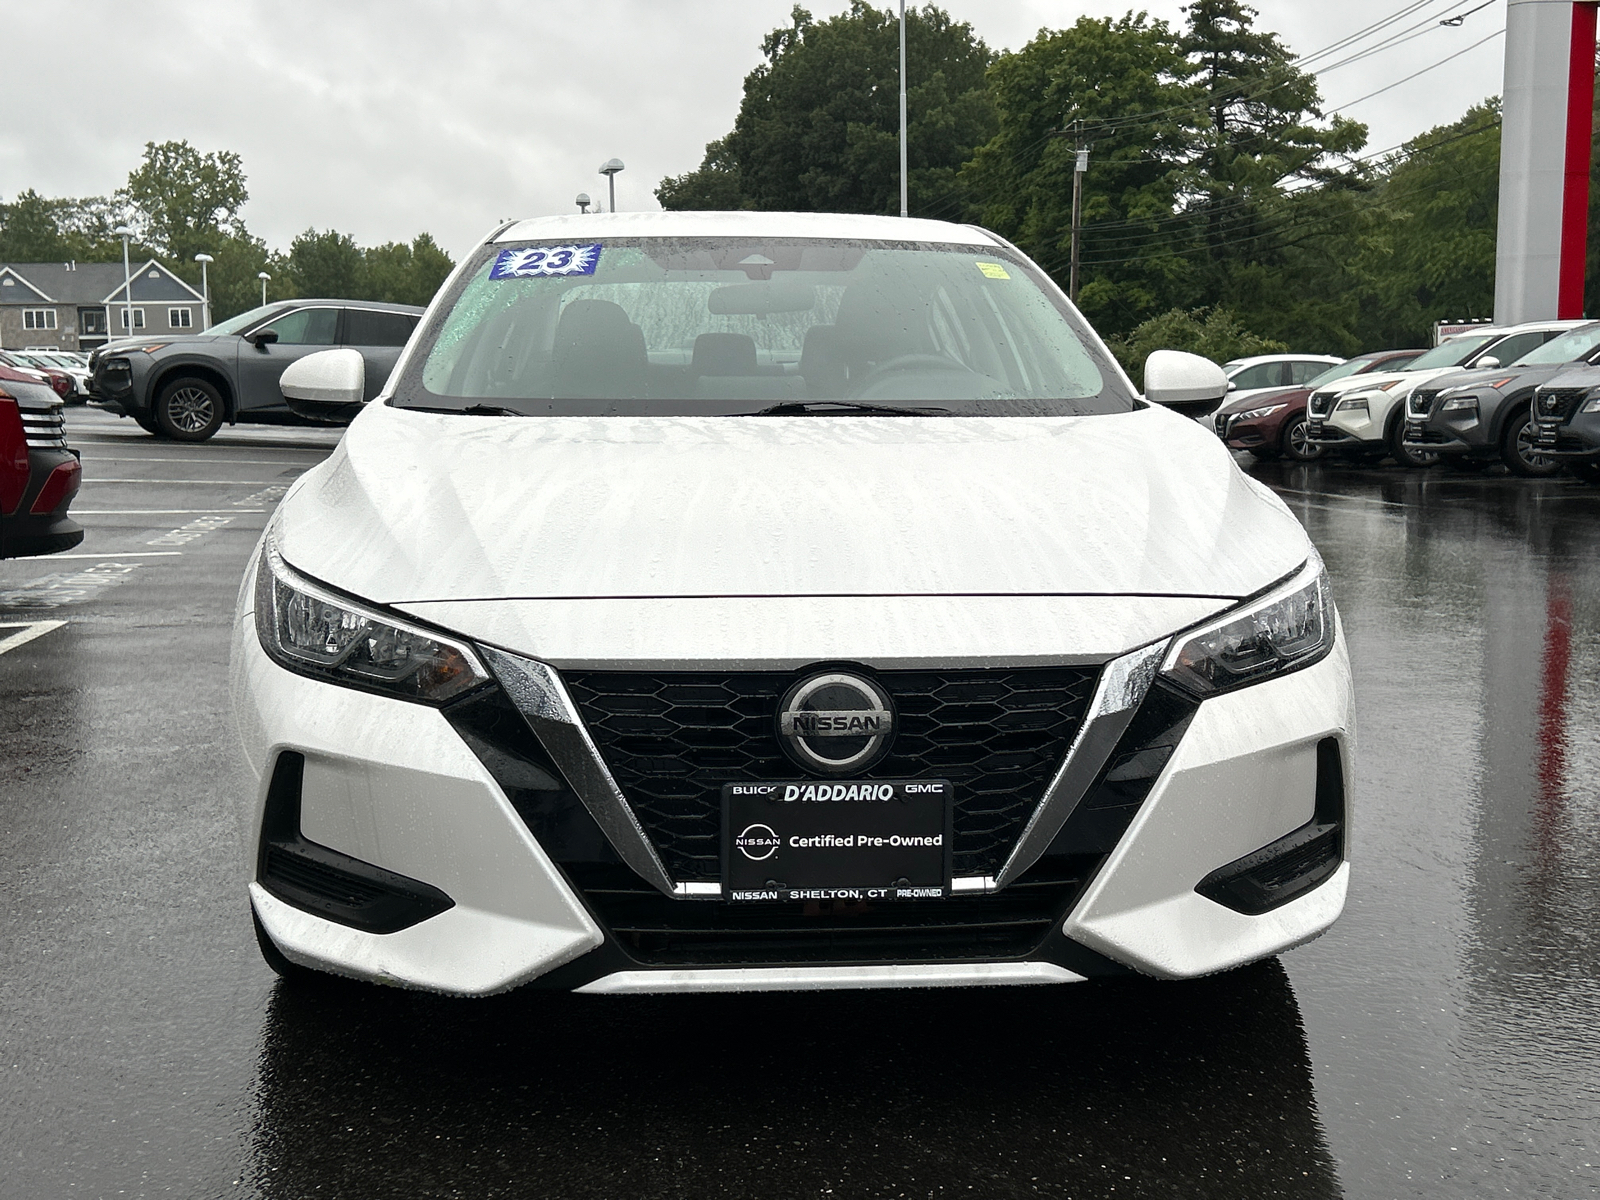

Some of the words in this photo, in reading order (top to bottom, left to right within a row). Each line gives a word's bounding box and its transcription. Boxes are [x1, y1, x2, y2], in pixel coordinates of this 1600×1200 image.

[515, 250, 574, 271] 23
[793, 716, 880, 731] NISSAN
[732, 786, 777, 795] BUICK
[784, 784, 894, 802] D'ADDARIO
[905, 784, 944, 793] GMC
[735, 838, 780, 846] NISSAN
[789, 835, 854, 848] Certified
[857, 834, 943, 847] Pre-Owned
[732, 891, 778, 900] NISSAN
[789, 889, 863, 899] SHELTON,
[867, 889, 888, 898] CT
[896, 888, 942, 898] PRE-OWNED
